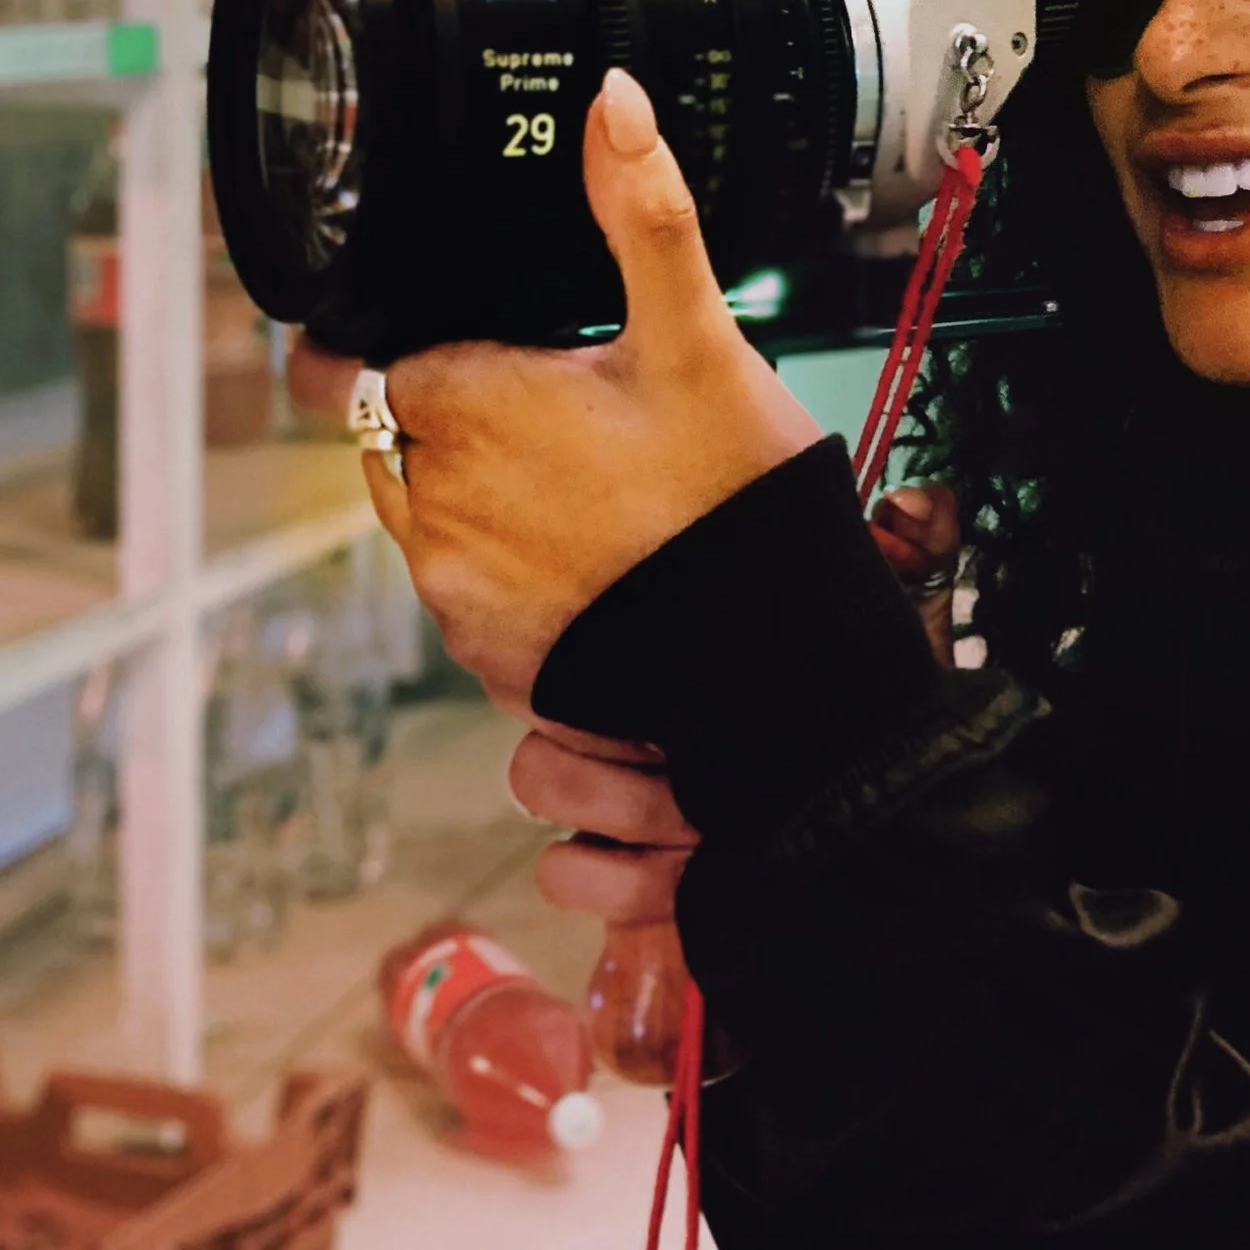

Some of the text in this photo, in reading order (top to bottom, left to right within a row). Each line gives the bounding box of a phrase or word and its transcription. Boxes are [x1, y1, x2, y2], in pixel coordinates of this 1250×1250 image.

[482, 48, 574, 70] Supreme
[500, 73, 560, 92] Prime
[502, 112, 556, 157] 29
